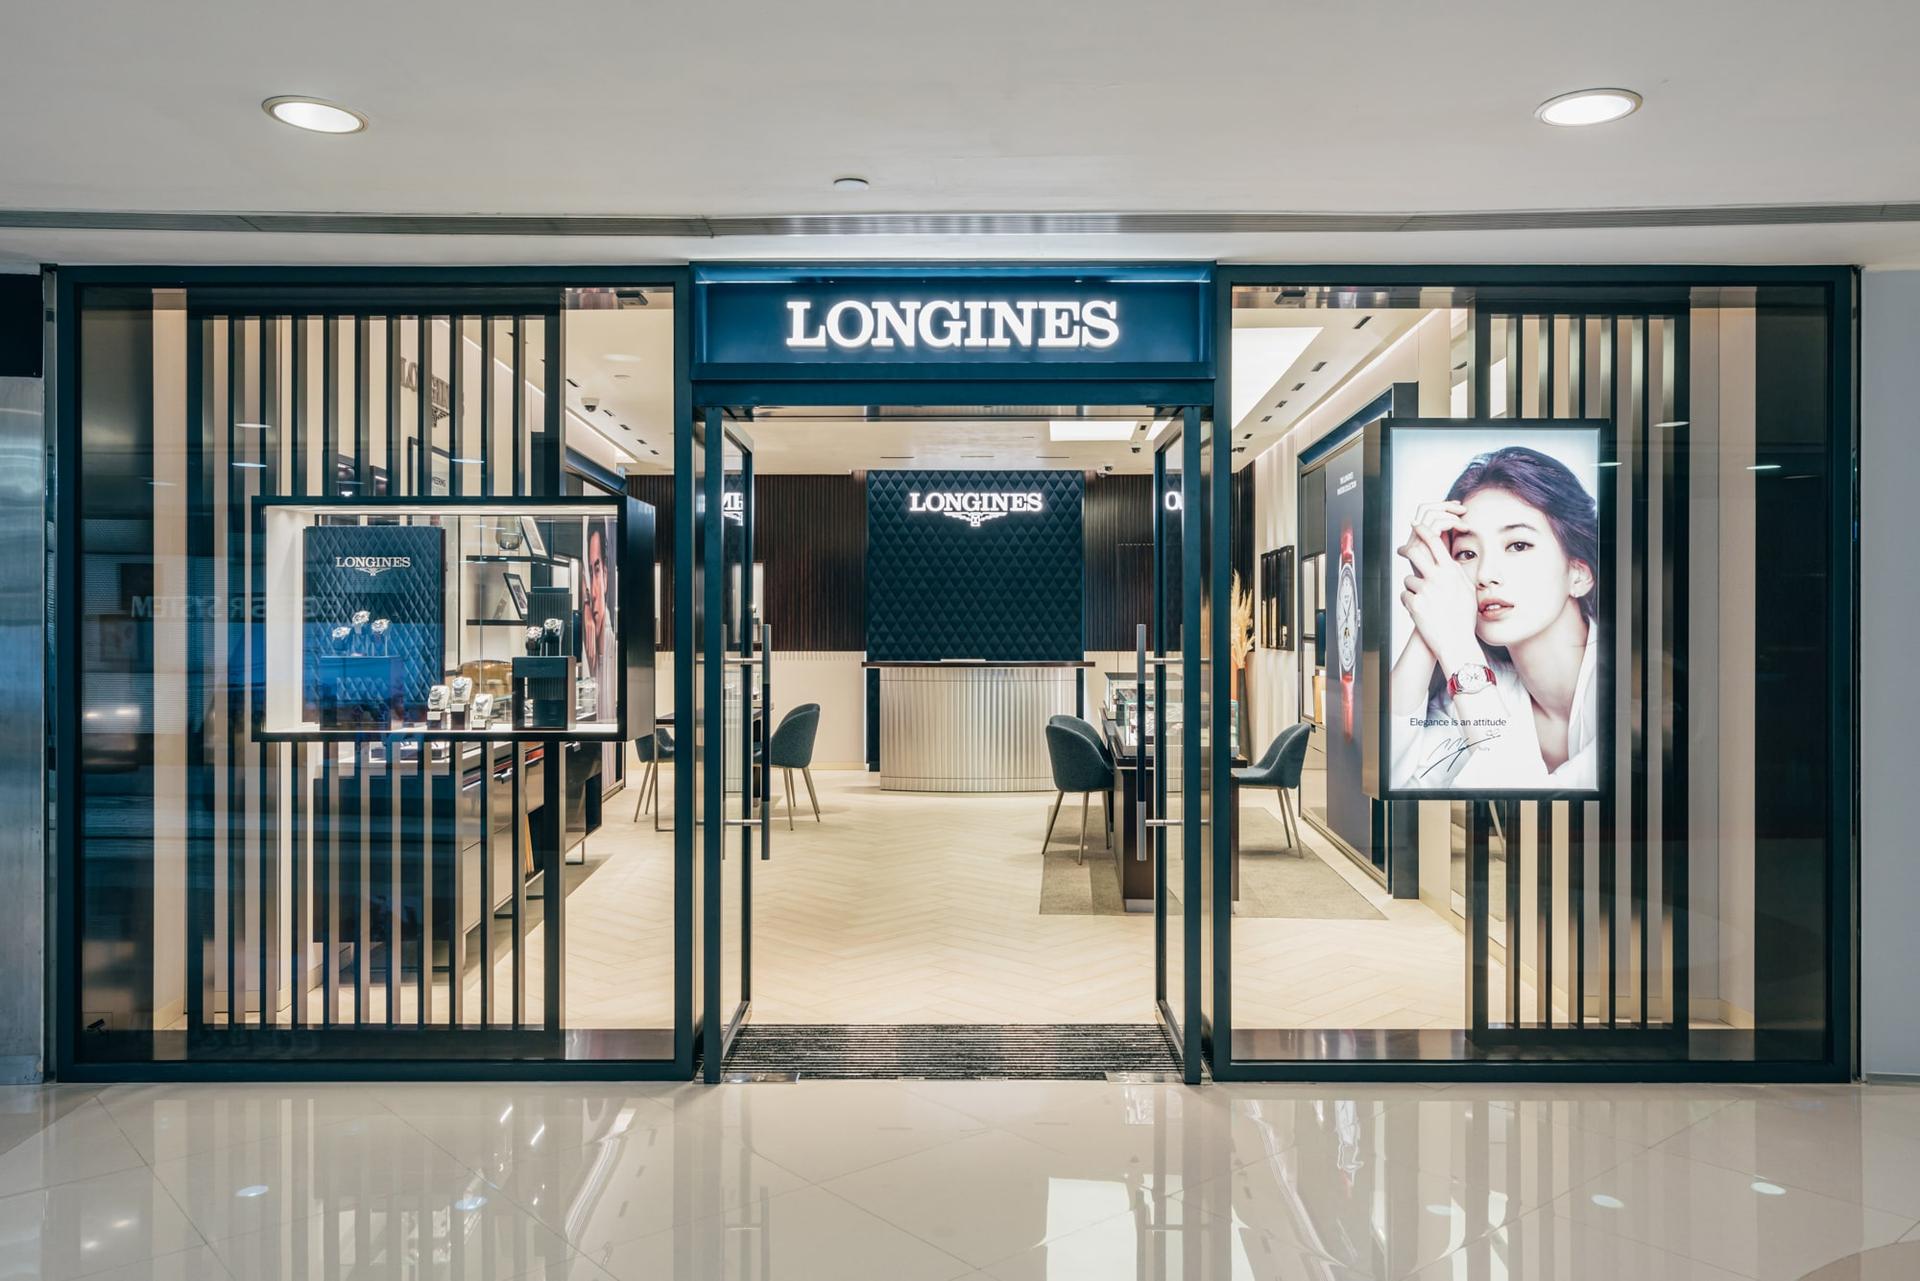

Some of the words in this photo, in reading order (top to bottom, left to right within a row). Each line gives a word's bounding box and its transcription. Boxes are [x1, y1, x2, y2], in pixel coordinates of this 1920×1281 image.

[786, 301, 1119, 348] LONGINES
[908, 492, 1043, 512] LONGINES
[335, 556, 411, 568] LONGINES
[1409, 718, 1450, 728] Elegance
[1451, 718, 1458, 726] is
[1473, 718, 1507, 726] attitude
